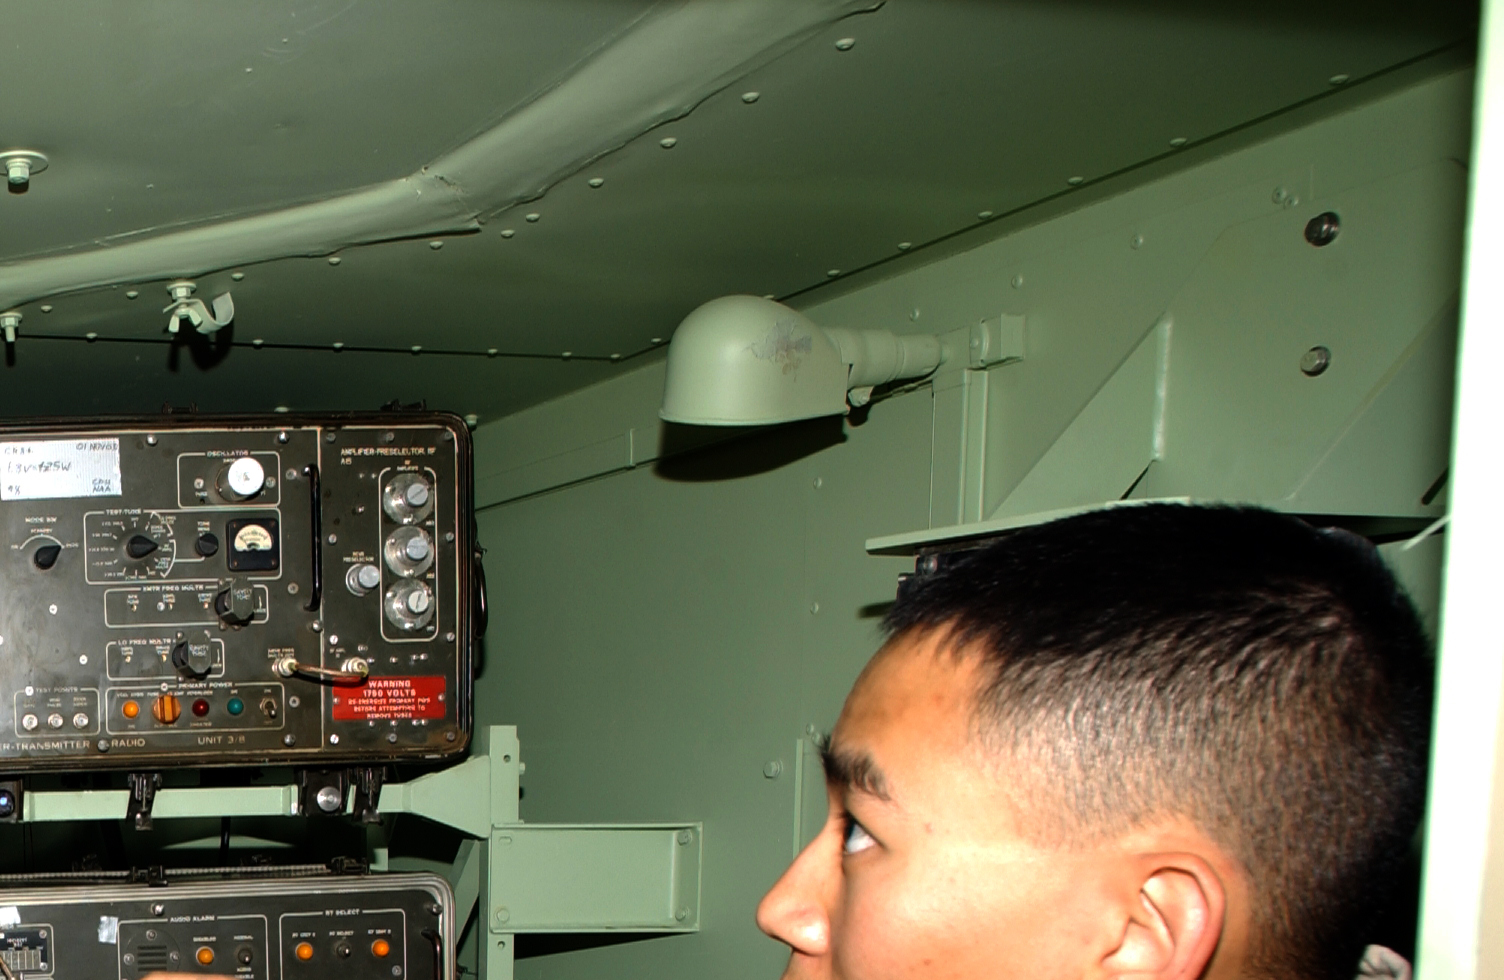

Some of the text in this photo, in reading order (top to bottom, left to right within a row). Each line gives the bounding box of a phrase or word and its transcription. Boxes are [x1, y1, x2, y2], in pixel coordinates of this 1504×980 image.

[368, 680, 411, 688] WARNING
[387, 688, 416, 697] VOLTS
[111, 738, 146, 748] RADIO
[198, 736, 223, 745] UNIT
